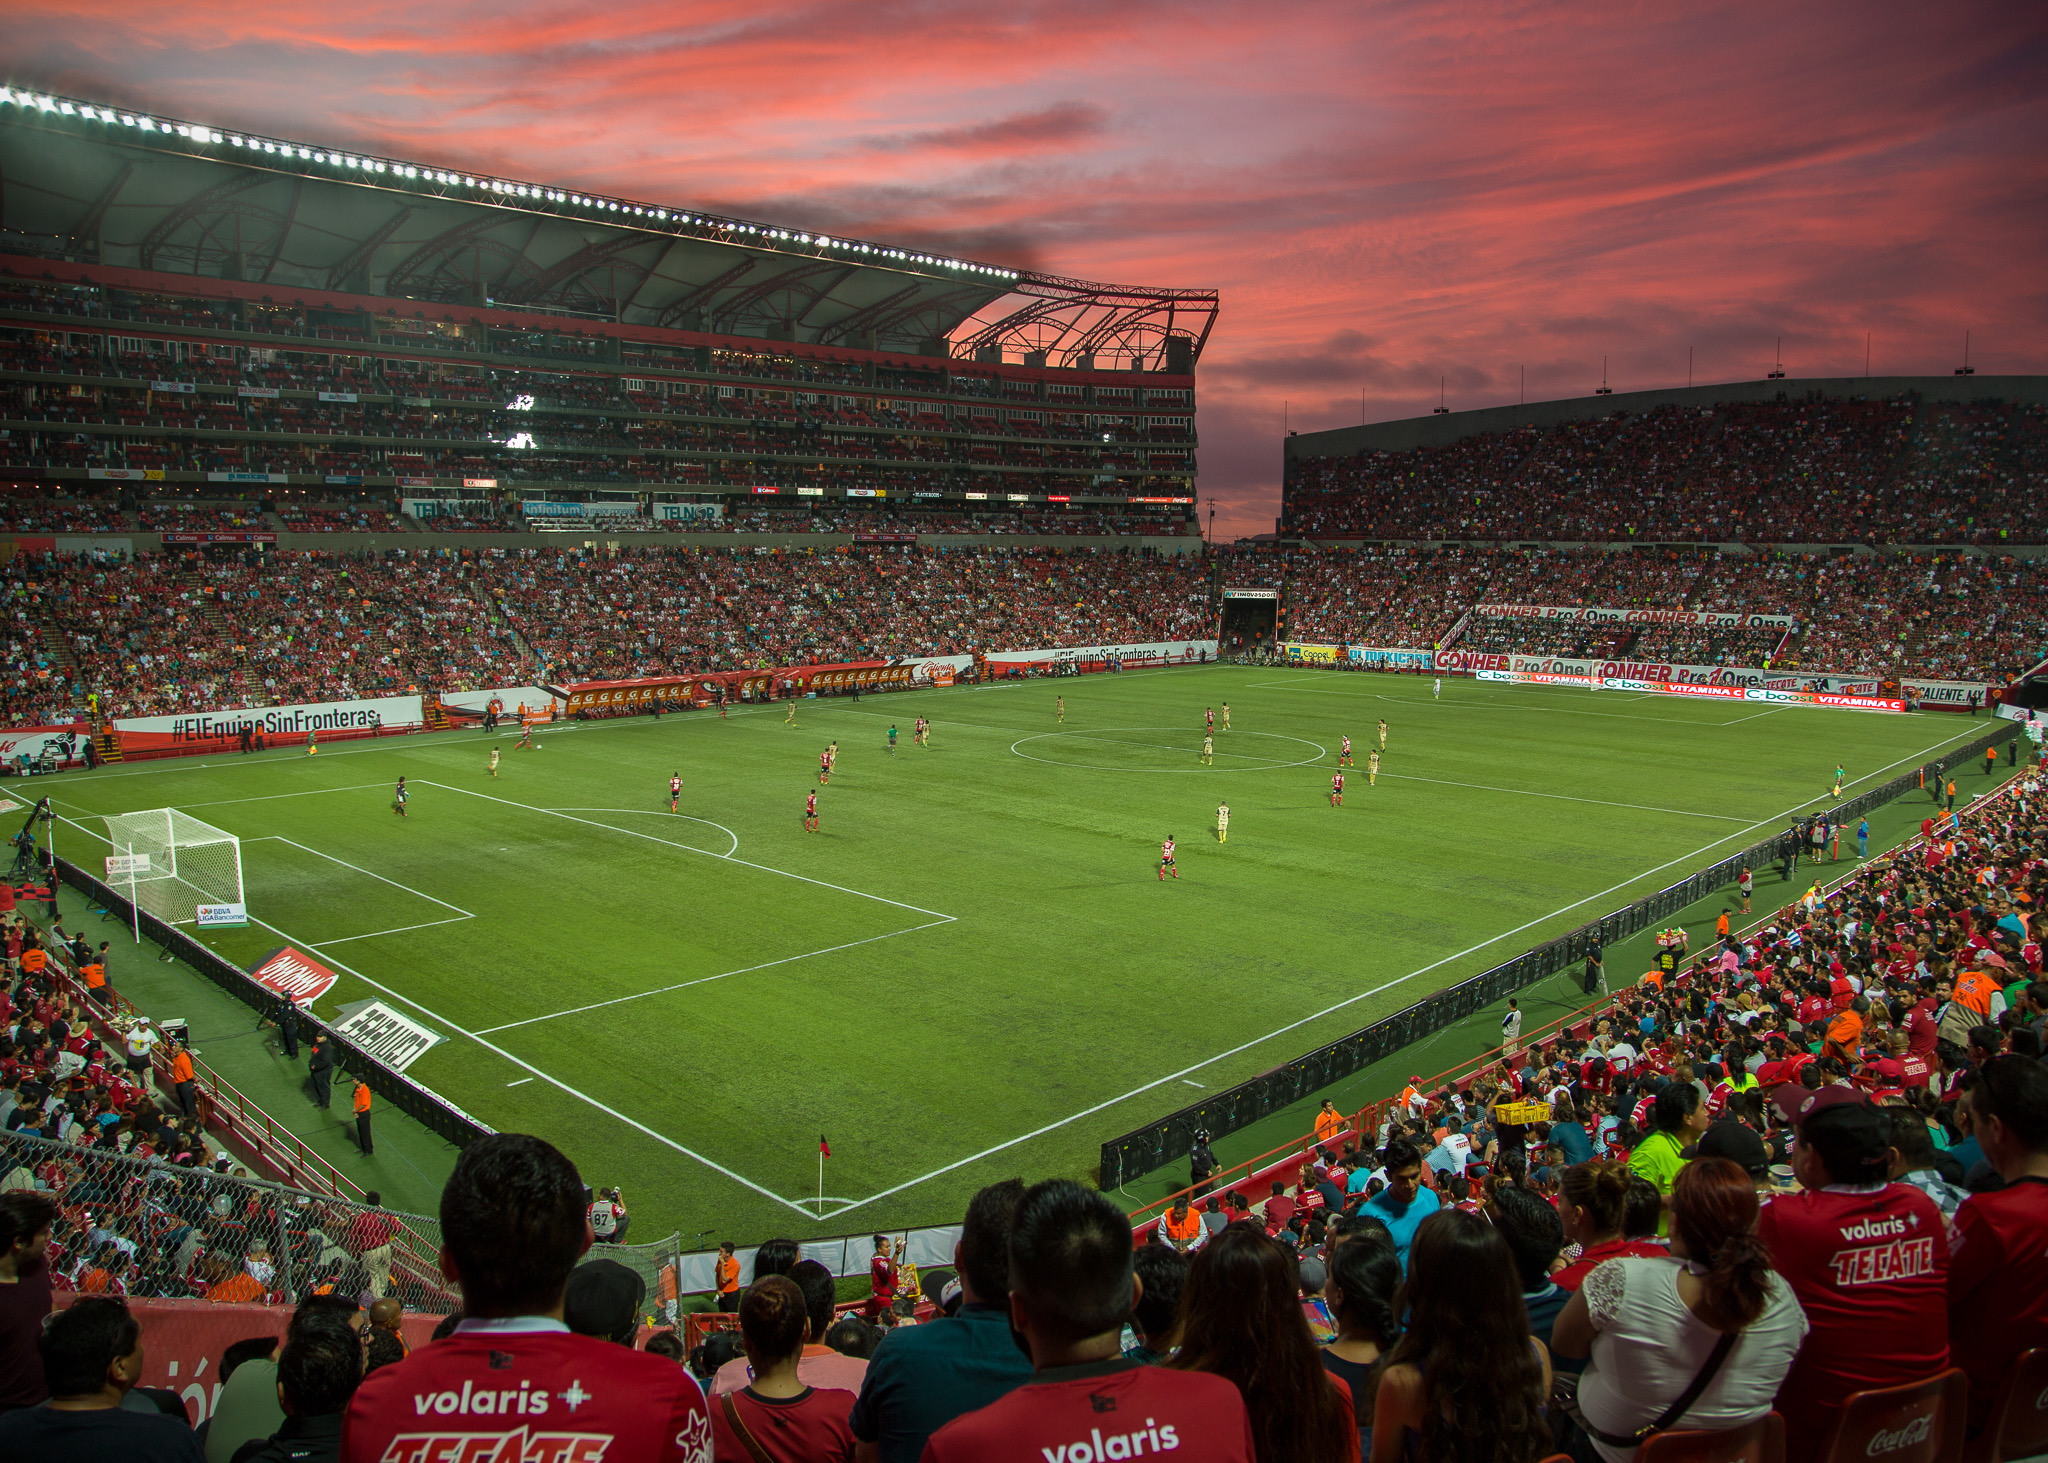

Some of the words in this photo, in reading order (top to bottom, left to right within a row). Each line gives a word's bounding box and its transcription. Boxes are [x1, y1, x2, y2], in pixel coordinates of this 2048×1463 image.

[526, 502, 580, 515] infinitum
[662, 506, 715, 520] TELNOR
[1476, 606, 1541, 617] GONHER
[1625, 611, 1699, 624] GONHER
[1304, 649, 1330, 659] Coppel
[1436, 651, 1509, 670] GONHER
[892, 669, 900, 677] G
[903, 668, 910, 676] G
[813, 675, 821, 683] G
[825, 674, 832, 682] G
[836, 673, 844, 681] G
[744, 680, 752, 688] G
[756, 679, 765, 687] G
[1766, 677, 1798, 690] TECATE
[657, 688, 665, 696] G
[670, 686, 678, 694] G
[683, 685, 691, 693] G
[1535, 675, 1591, 684] VITAMINA
[1668, 685, 1731, 695] VITAMINA
[1733, 689, 1742, 697] C
[1818, 696, 1888, 708] VITAMINA
[1890, 701, 1901, 709] C
[1840, 682, 1874, 694] TCATE
[585, 693, 594, 702] G
[600, 692, 608, 701] G
[614, 691, 623, 699] G
[629, 690, 637, 698] G
[643, 689, 651, 698] G
[1919, 686, 1985, 702] CALIENTE.MX
[571, 694, 580, 703] G
[213, 907, 231, 915] BBVA
[337, 1008, 429, 1069] CONVERSE
[1904, 1063, 1928, 1076] TECATE
[595, 1213, 608, 1226] 87
[1840, 1215, 1906, 1242] volaris
[1829, 1237, 1935, 1286] TECATE
[414, 1380, 549, 1416] volaris
[1866, 1414, 1933, 1457] Coca-Cola
[1042, 1418, 1180, 1463] volaris
